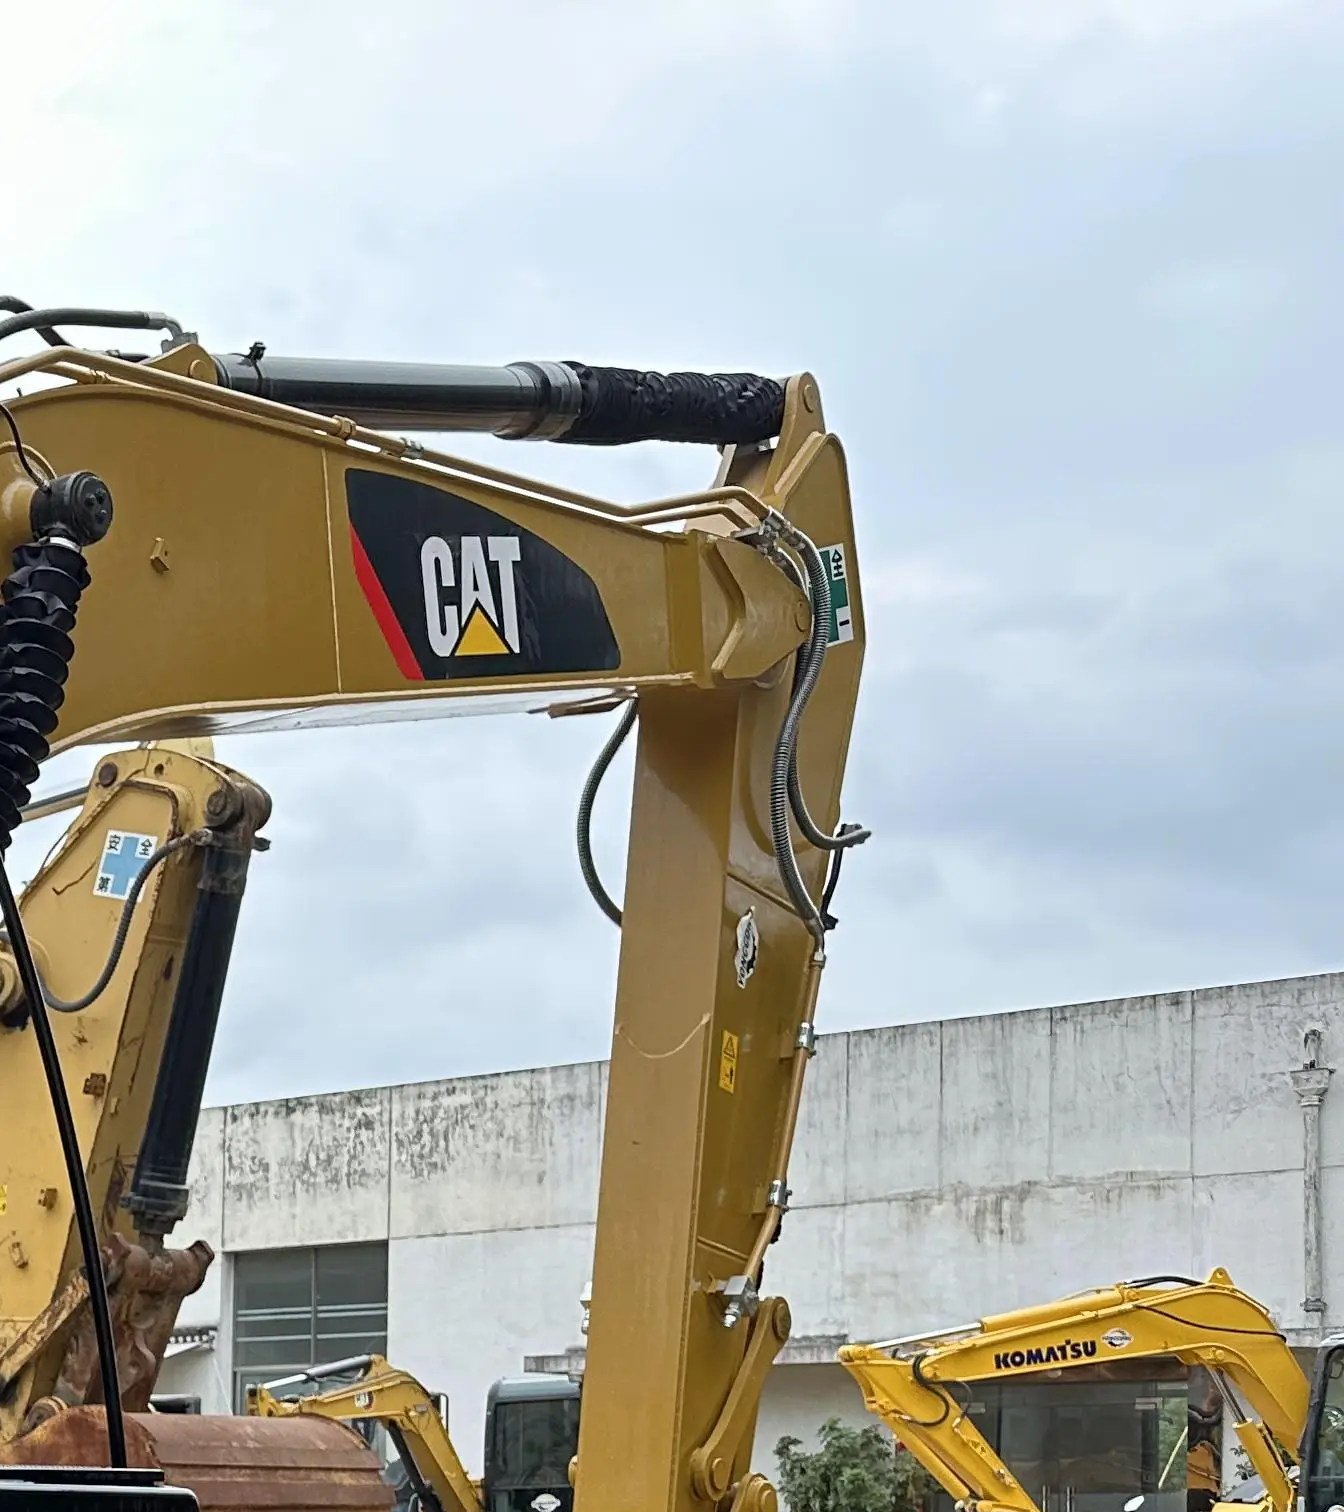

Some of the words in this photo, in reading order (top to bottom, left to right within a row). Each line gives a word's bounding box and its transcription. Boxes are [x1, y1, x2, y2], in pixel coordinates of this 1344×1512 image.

[831, 549, 844, 578] 全
[421, 536, 521, 657] CAT
[994, 1339, 1097, 1369] KOMATSU
